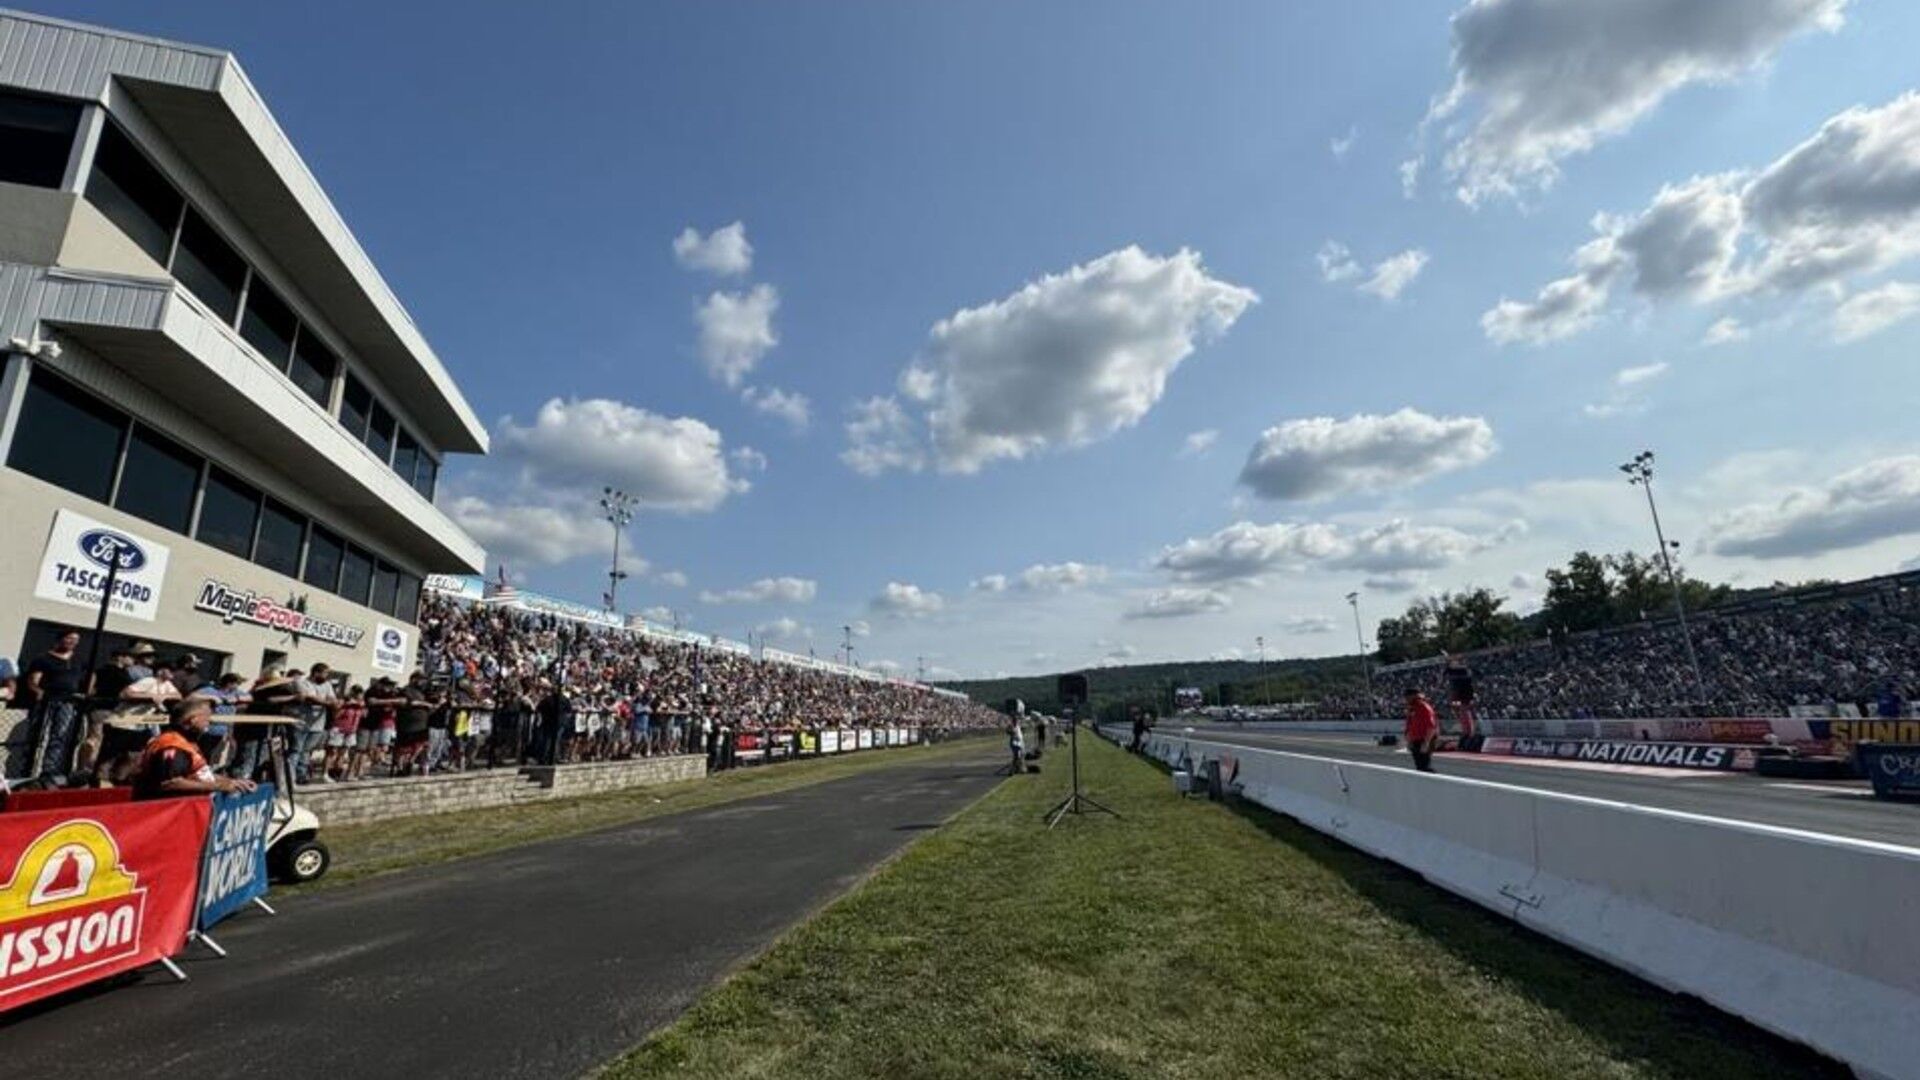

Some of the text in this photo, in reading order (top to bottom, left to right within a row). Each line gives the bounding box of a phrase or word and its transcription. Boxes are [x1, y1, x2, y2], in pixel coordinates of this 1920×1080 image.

[56, 563, 151, 602] TASCA FORD
[1579, 742, 1726, 767] NATIONALS
[213, 799, 267, 854] CAMPING
[204, 837, 260, 908] WORLD
